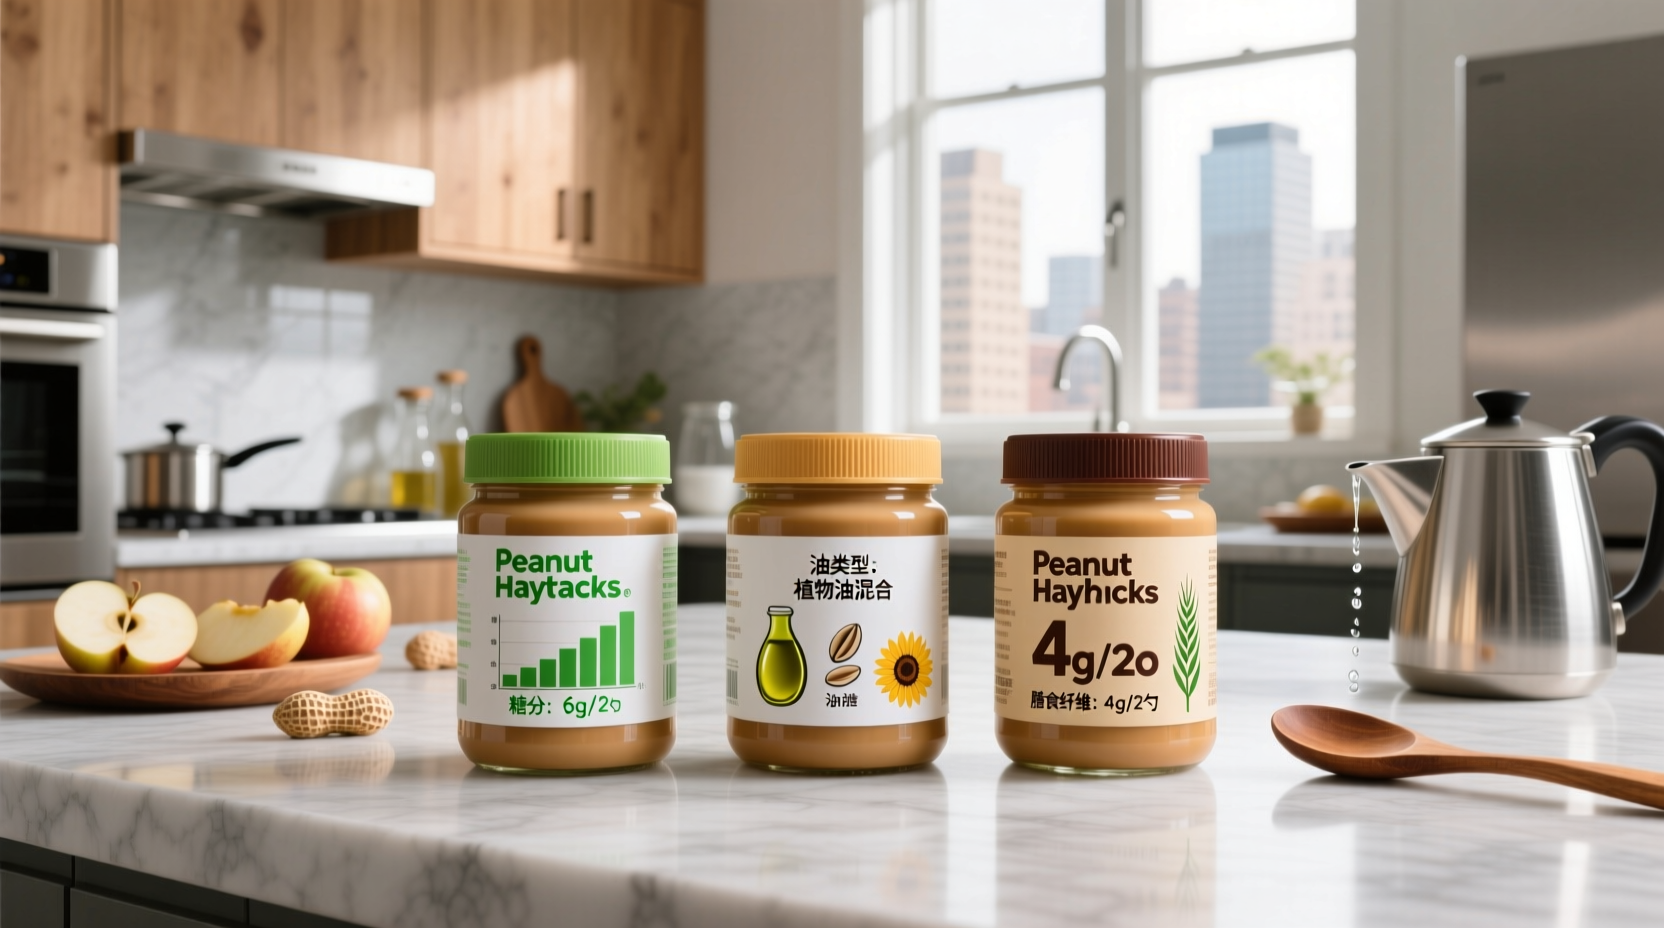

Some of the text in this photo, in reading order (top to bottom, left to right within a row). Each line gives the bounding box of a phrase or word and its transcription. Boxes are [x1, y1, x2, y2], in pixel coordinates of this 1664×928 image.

[496, 548, 593, 573] Peanut
[1033, 550, 1132, 576] Peanut
[794, 578, 893, 601] 植物油混合
